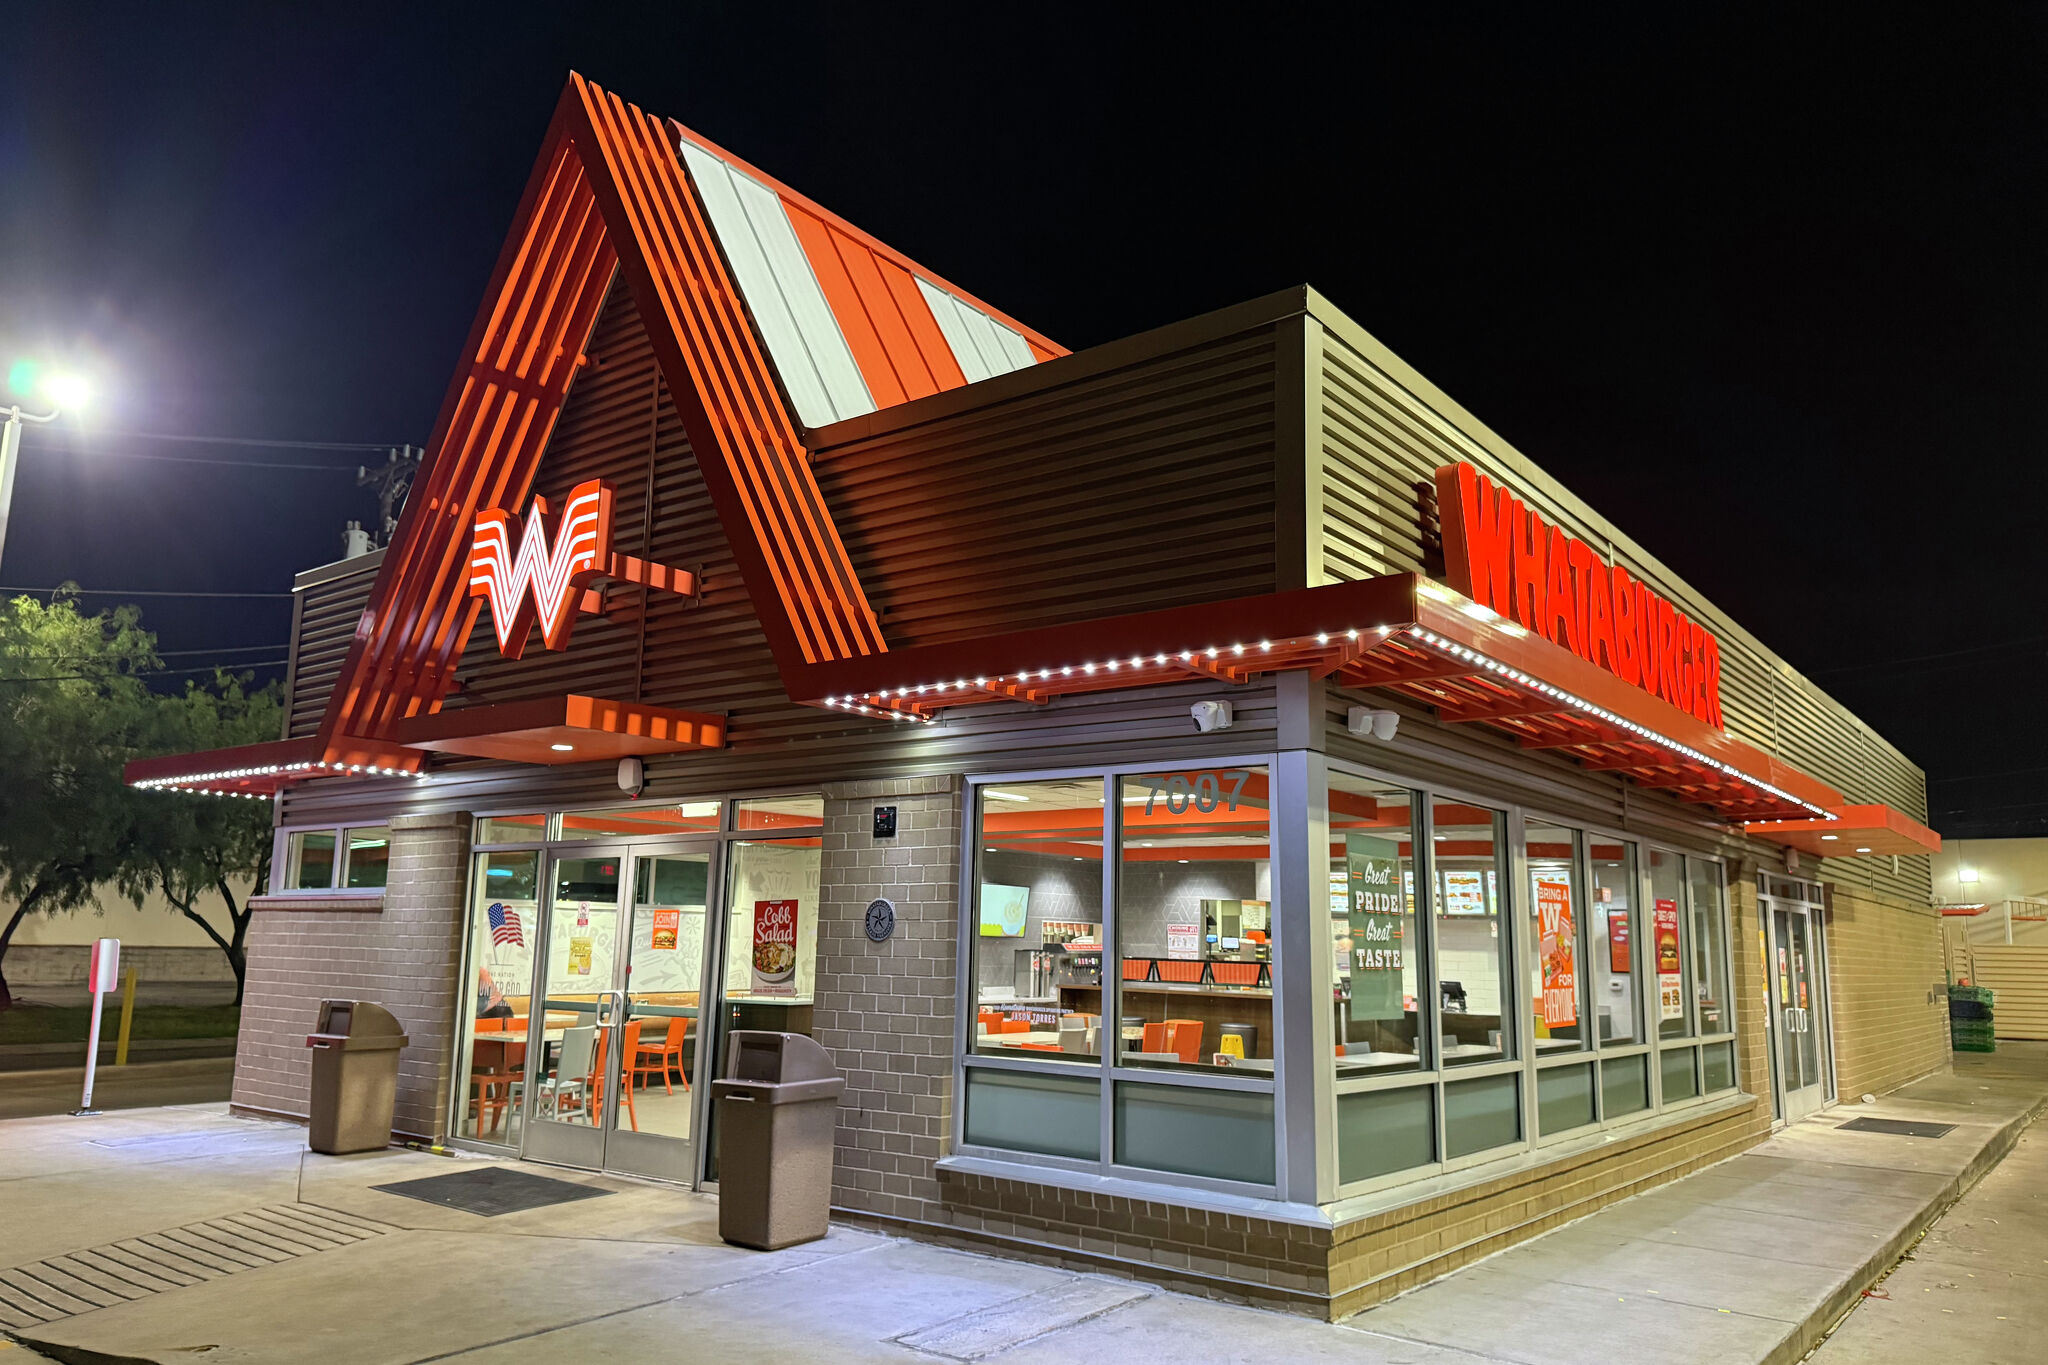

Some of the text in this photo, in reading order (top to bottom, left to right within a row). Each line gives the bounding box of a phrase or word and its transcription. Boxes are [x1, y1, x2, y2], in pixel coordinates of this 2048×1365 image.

[469, 478, 601, 655] W
[1456, 461, 1725, 732] WHATABURGER
[1140, 771, 1250, 816] 7007
[1364, 861, 1392, 886] Great
[1538, 887, 1569, 902] BRING A
[764, 905, 792, 927] Cobb
[1539, 902, 1563, 933] W
[755, 921, 795, 944] Salad
[1366, 918, 1394, 942] Great
[506, 981, 521, 997] GOD
[1558, 973, 1573, 986] FOR
[1543, 987, 1575, 1024] EVERYONE
[1011, 1011, 1057, 1025] JASON TORRES
